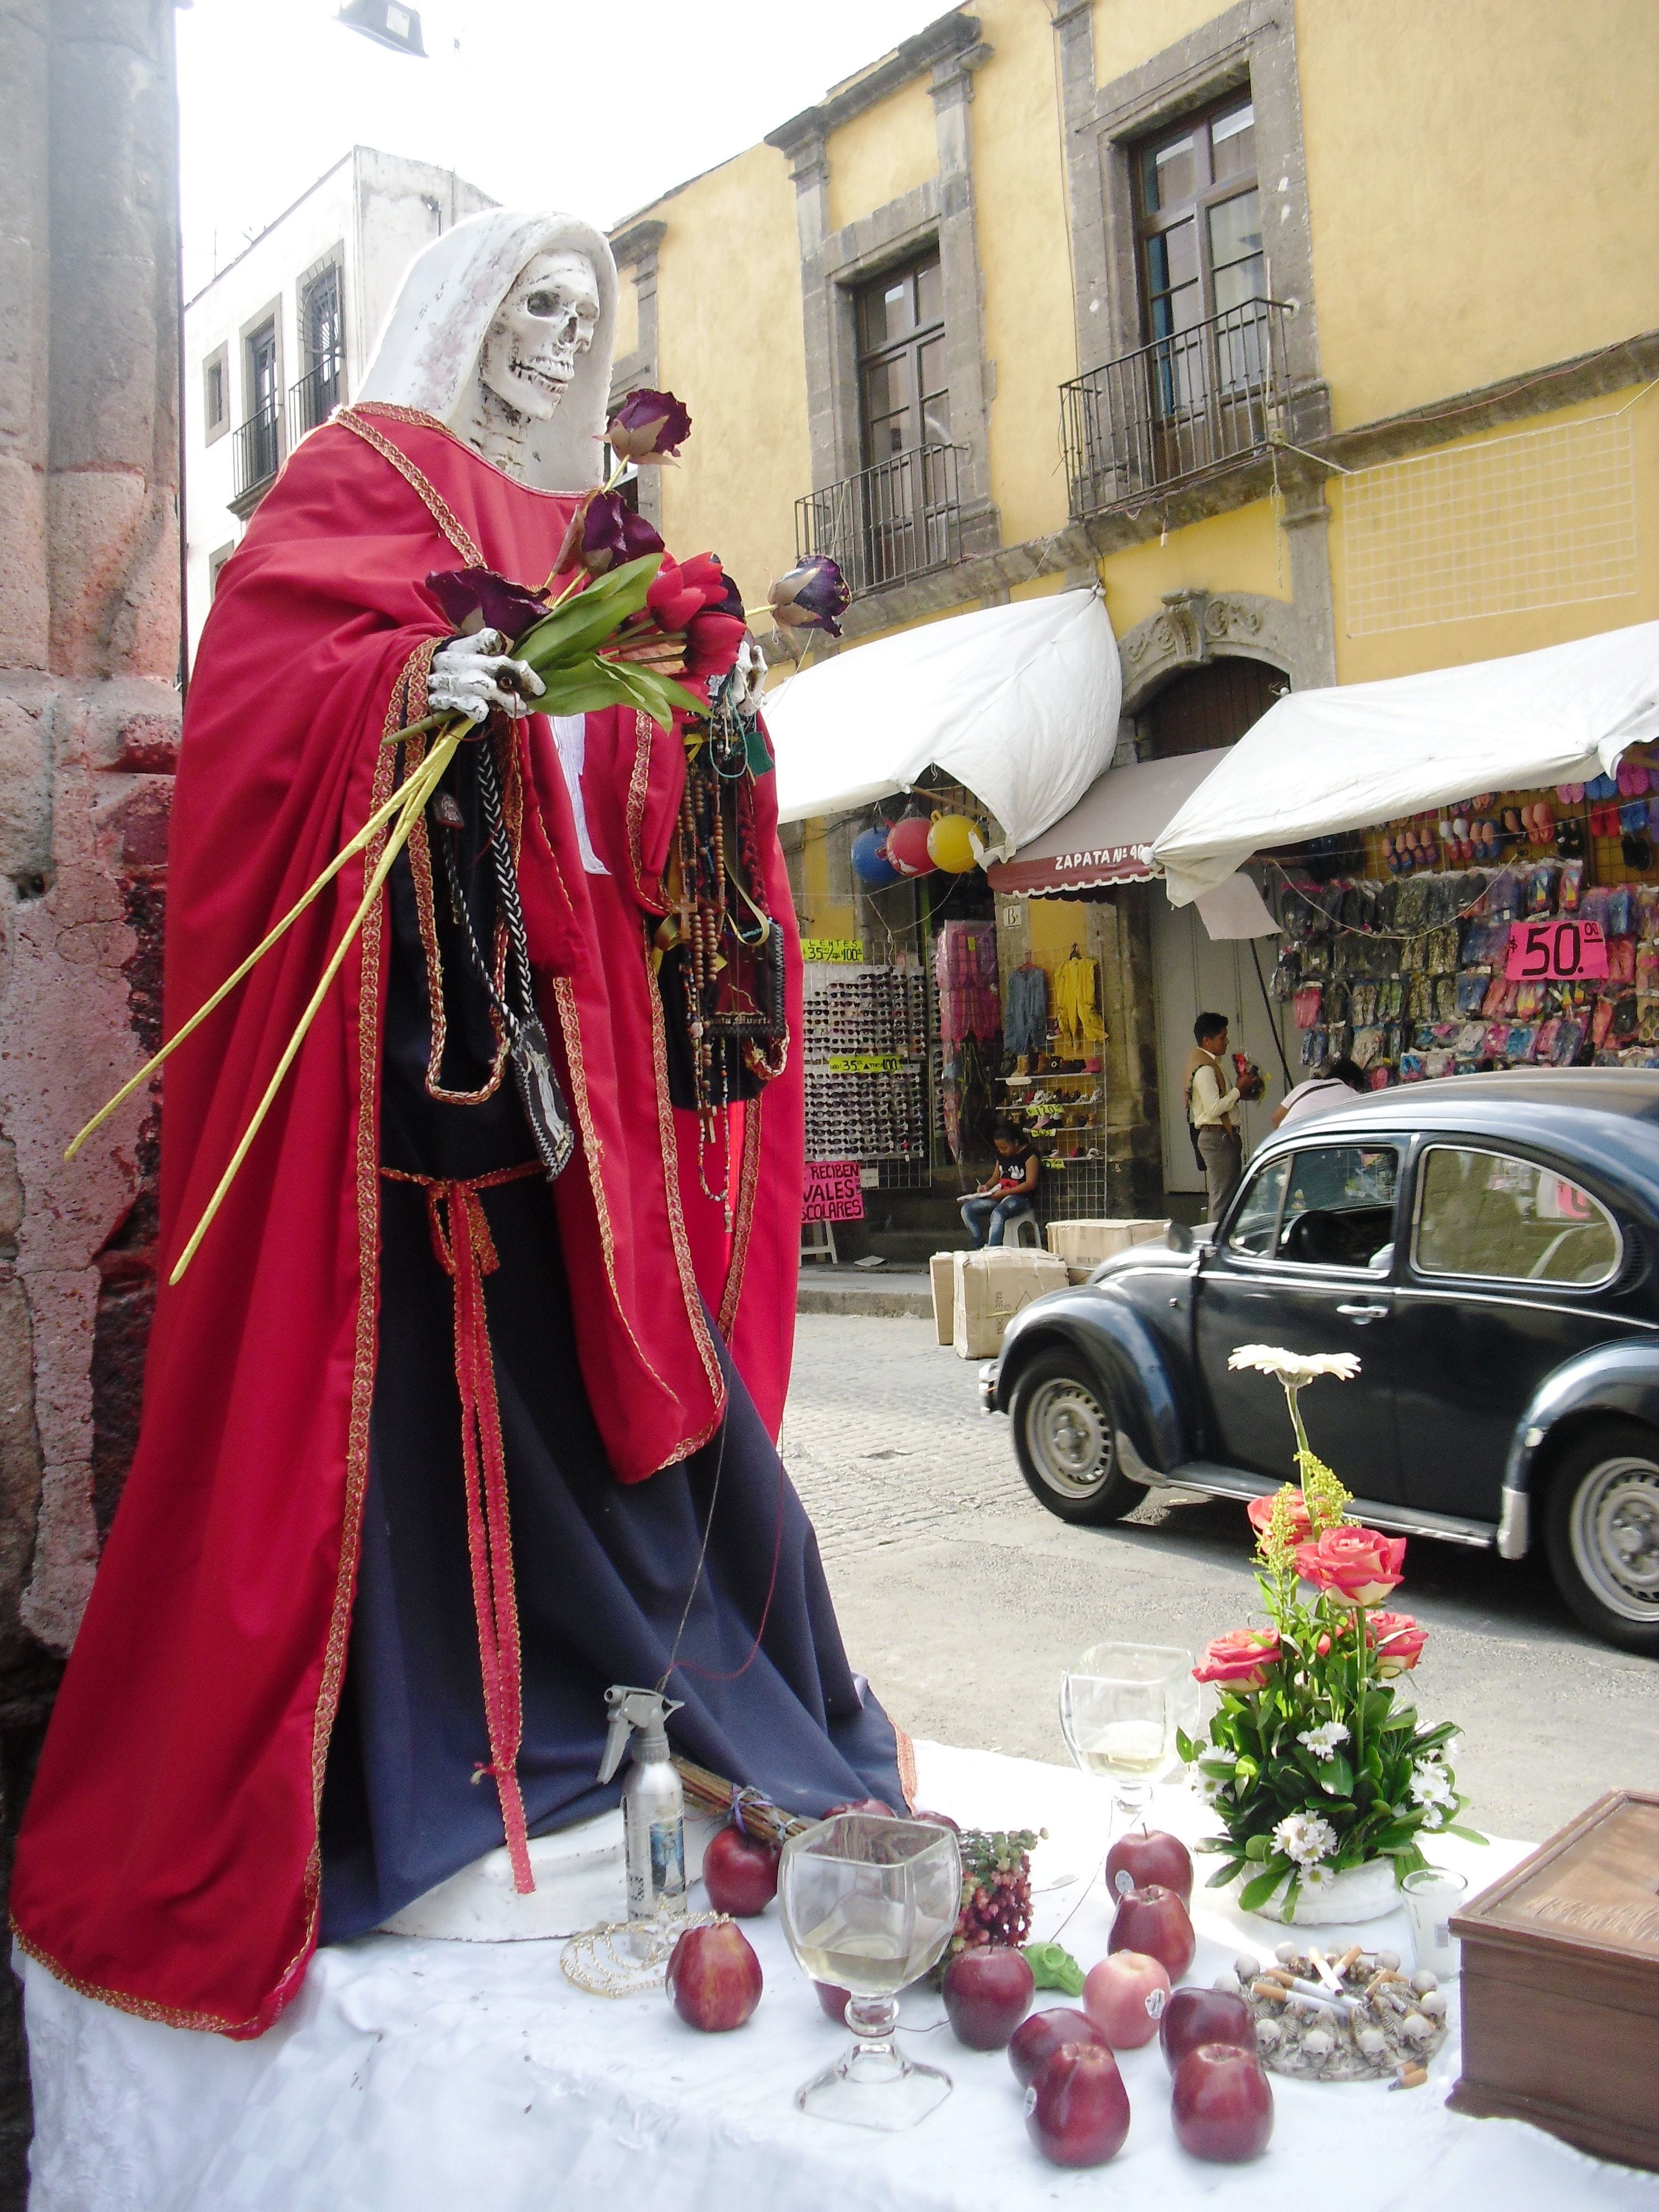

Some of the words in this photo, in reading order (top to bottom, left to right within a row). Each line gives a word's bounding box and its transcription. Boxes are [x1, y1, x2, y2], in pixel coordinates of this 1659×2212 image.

[1055, 849, 1110, 871] ZAPATA
[808, 940, 858, 948] LENTES
[810, 1164, 859, 1180] RECIBEN
[803, 1179, 855, 1203] VALES
[801, 1199, 862, 1222] SCOLARES
